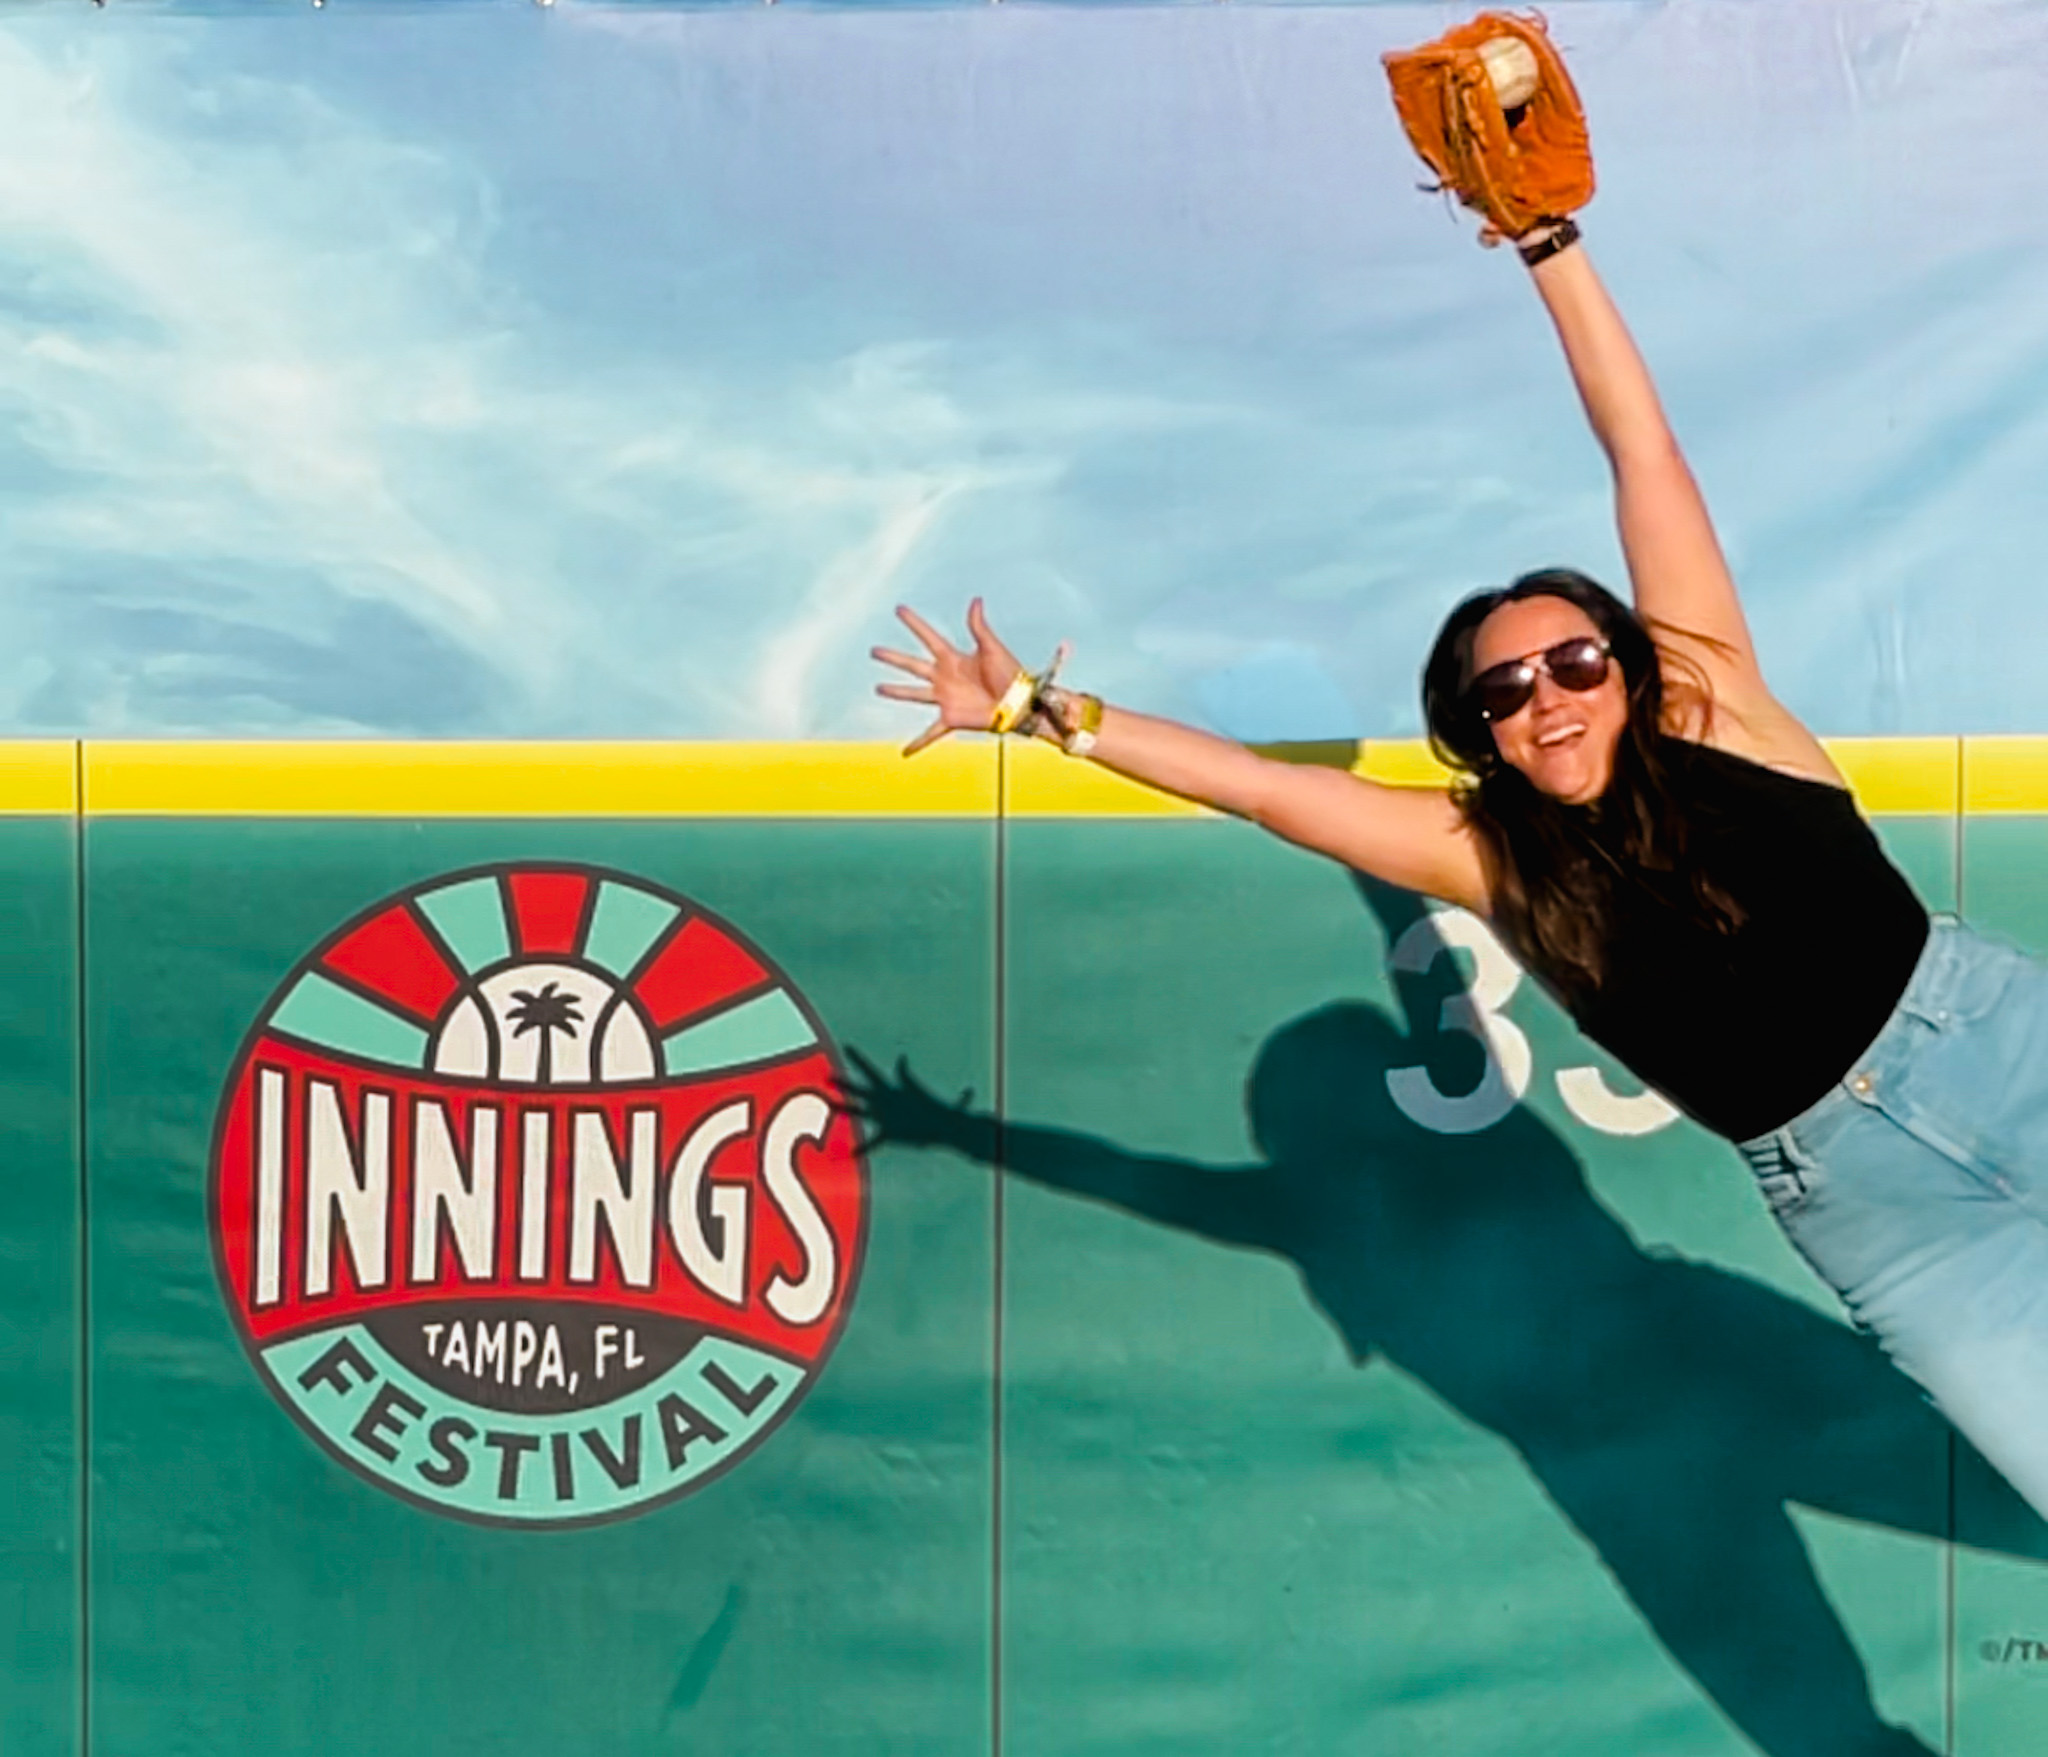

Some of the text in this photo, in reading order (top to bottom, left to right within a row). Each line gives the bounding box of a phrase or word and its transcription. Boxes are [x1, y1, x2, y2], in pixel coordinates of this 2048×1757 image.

[255, 1067, 836, 1325] INNINGS
[297, 1337, 779, 1501] FESTIVAL
[423, 1321, 645, 1394] TAMPA, FL
